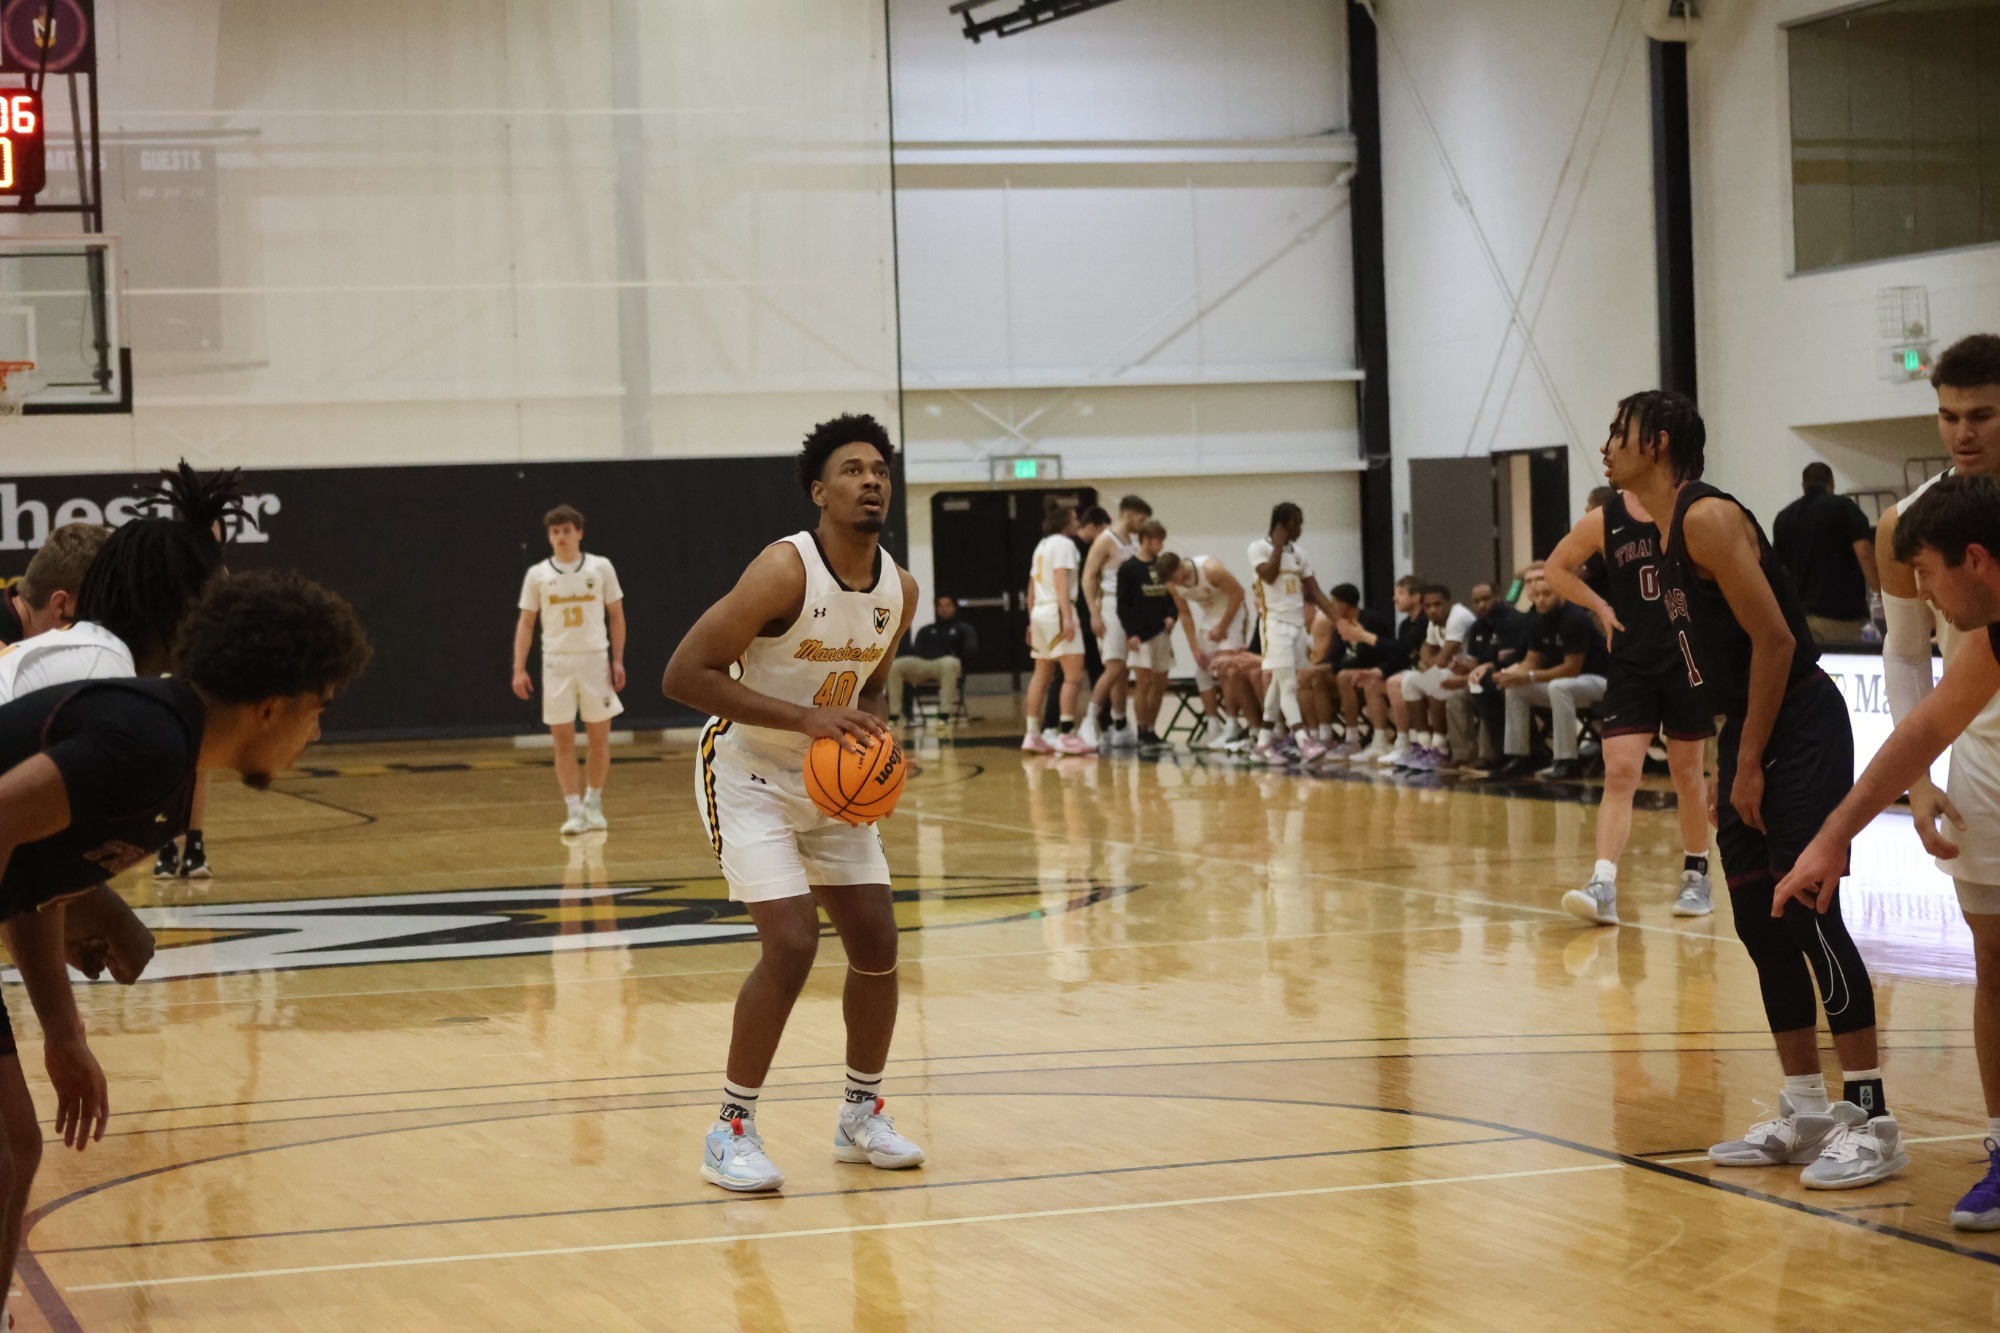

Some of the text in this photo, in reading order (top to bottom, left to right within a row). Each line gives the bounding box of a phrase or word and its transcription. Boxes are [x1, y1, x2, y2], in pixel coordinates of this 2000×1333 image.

[140, 150, 202, 171] GUESTS
[1615, 539, 1652, 568] TRA
[1639, 565, 1660, 601] 0
[563, 606, 584, 628] 13
[794, 638, 884, 662] Manchester
[1679, 630, 1703, 688] 1
[813, 670, 858, 708] 40
